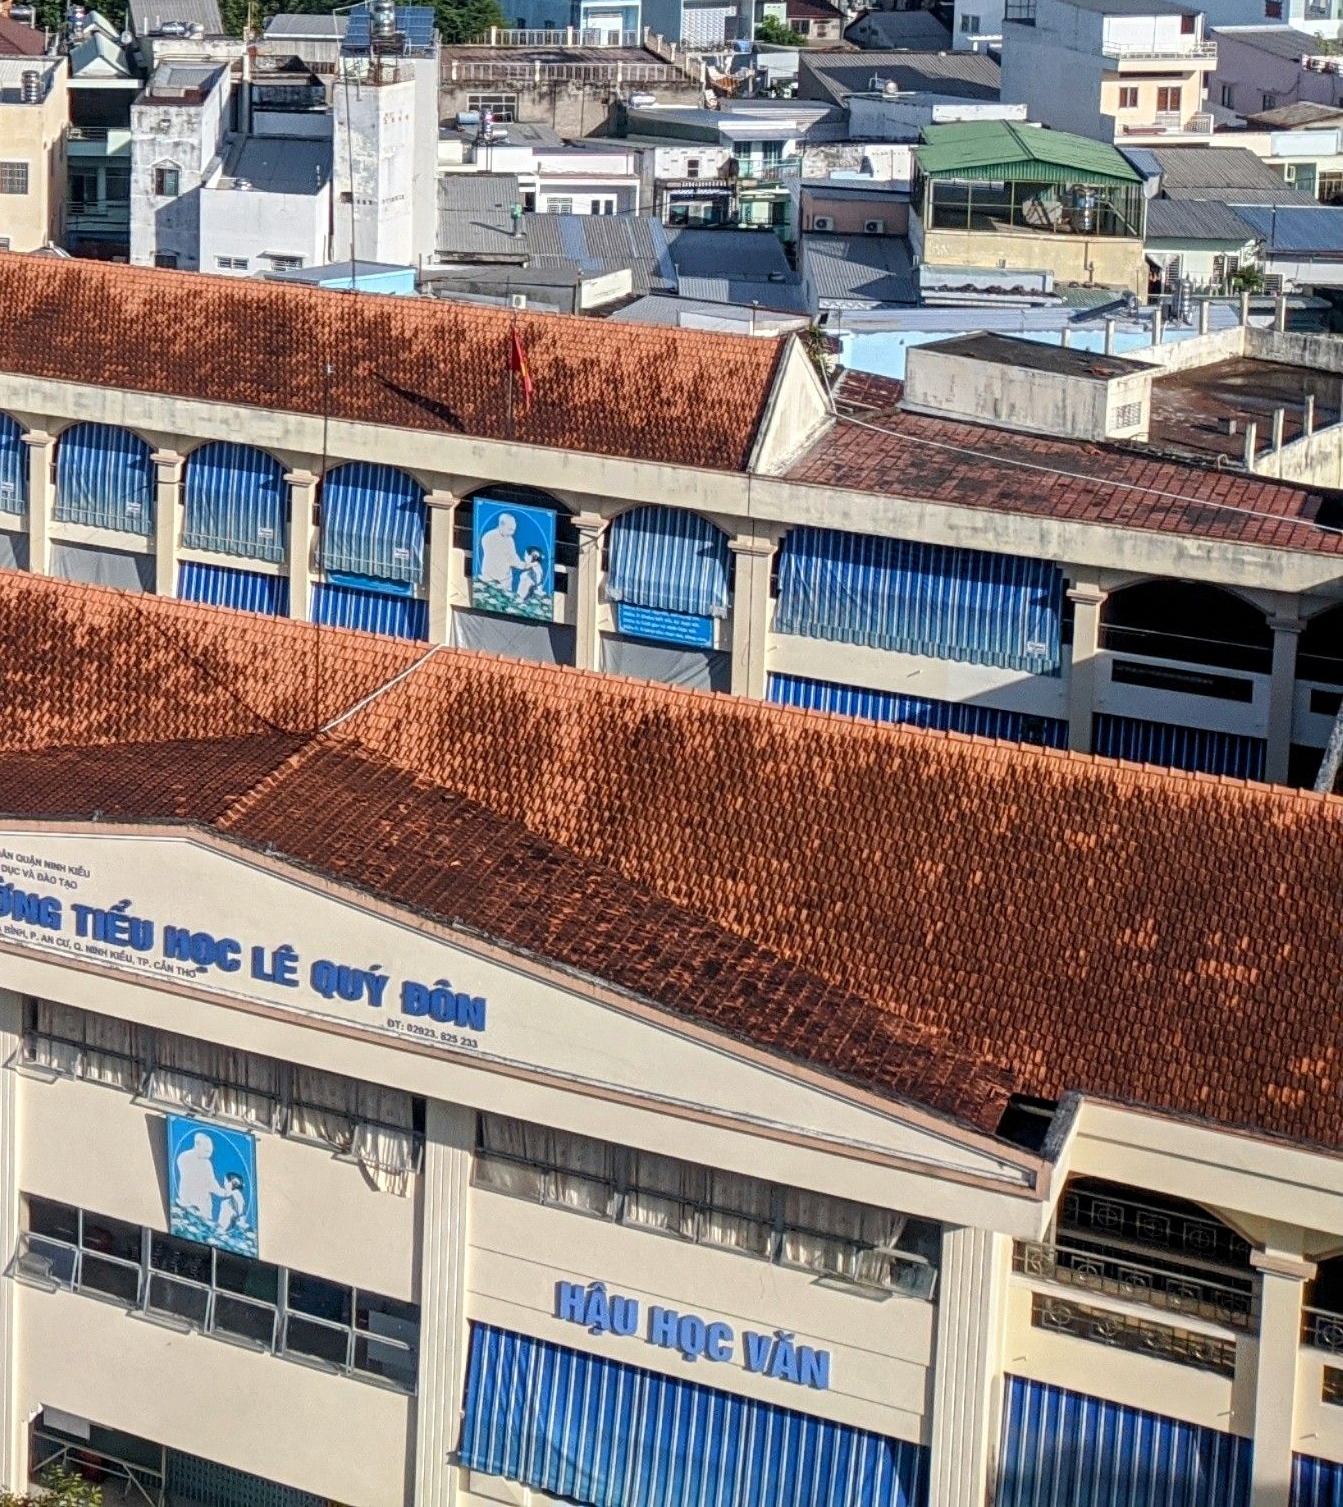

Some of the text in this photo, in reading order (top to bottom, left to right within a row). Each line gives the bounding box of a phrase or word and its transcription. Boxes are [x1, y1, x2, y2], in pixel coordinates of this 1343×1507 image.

[16, 851, 42, 867] QUẬN
[44, 859, 66, 873] NINH
[1, 863, 21, 877] DỤC
[22, 867, 35, 880] VÀ
[37, 872, 57, 885] ĐÀO
[59, 876, 78, 890] TẠO
[41, 935, 54, 945] AN
[71, 899, 155, 951] TIỂU
[163, 925, 242, 973] HỌC
[251, 944, 300, 987] LÊ
[309, 959, 389, 1007] QUÝ
[400, 979, 487, 1032] ĐÔN
[460, 1036, 479, 1049] 233
[552, 1280, 831, 1391] HẬU HỌC VĂN
